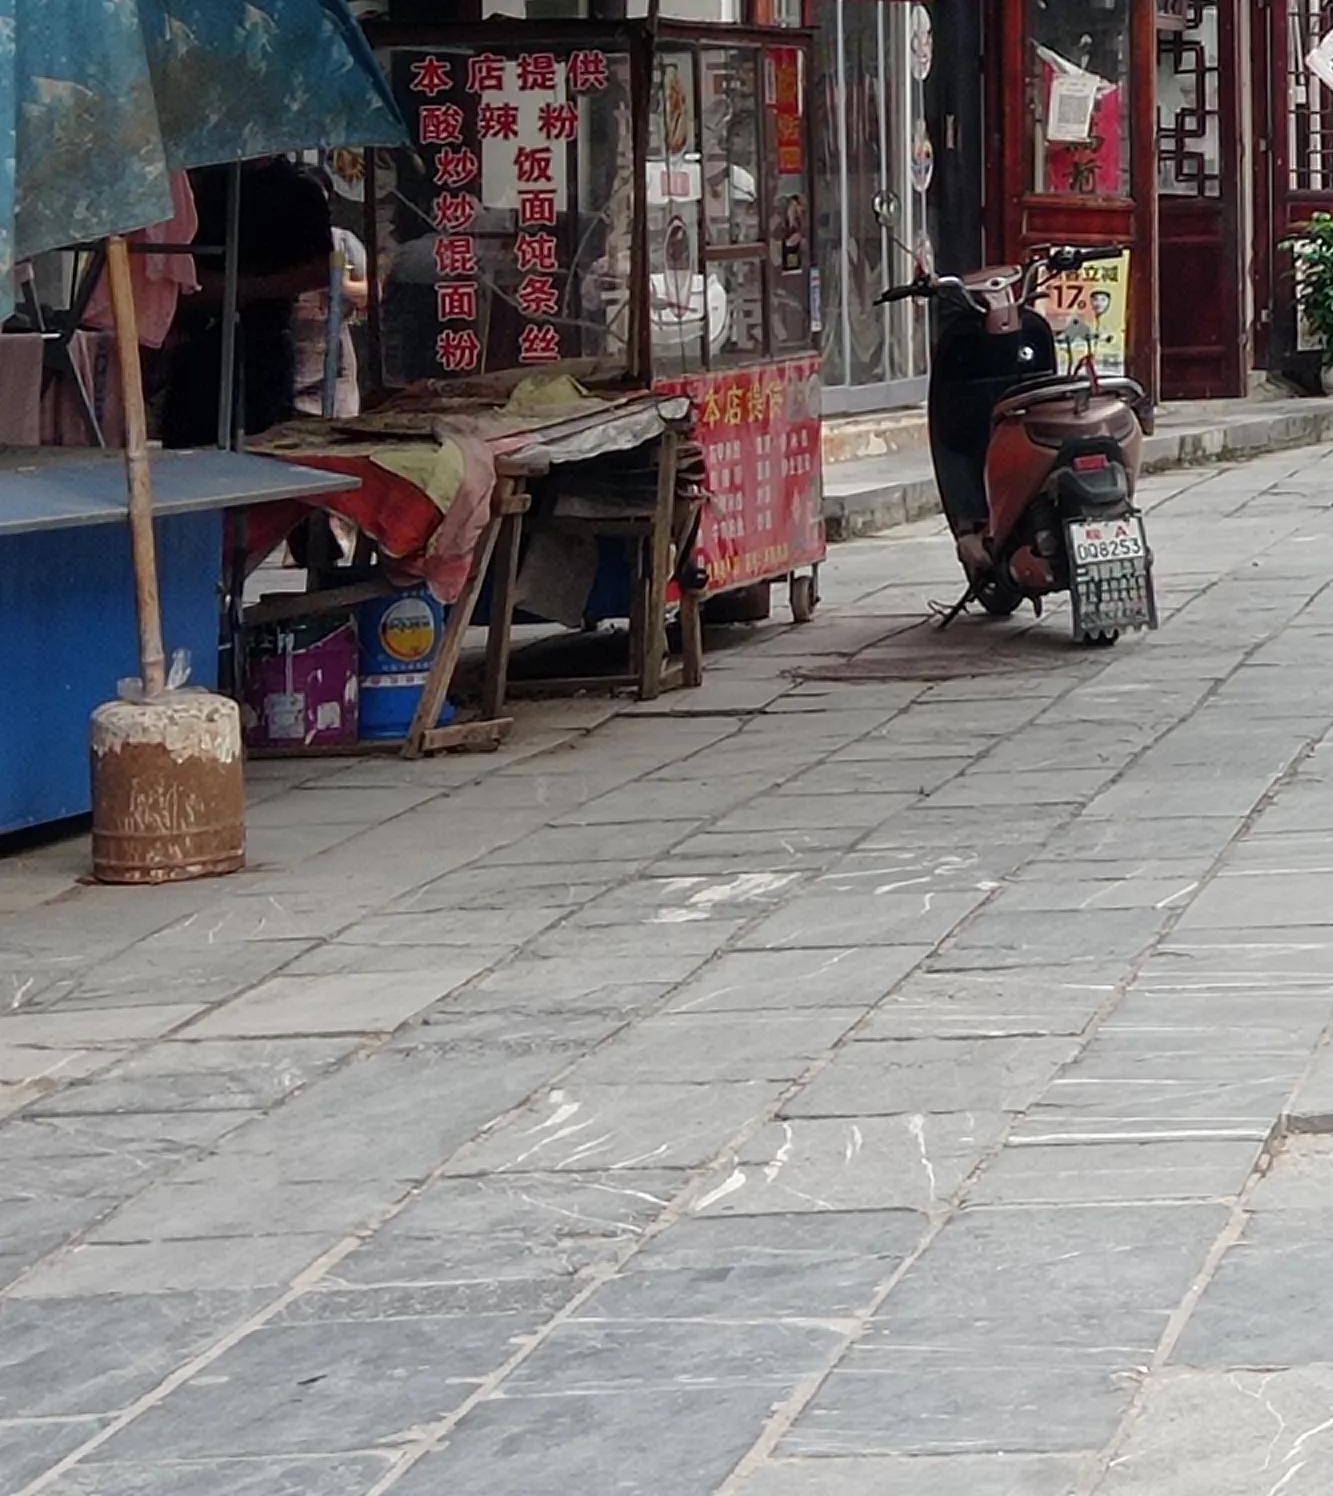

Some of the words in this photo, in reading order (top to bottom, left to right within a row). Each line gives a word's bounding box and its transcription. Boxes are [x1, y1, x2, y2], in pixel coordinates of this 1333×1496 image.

[411, 51, 609, 96] 本店提供
[419, 102, 578, 142] 酸辣粉
